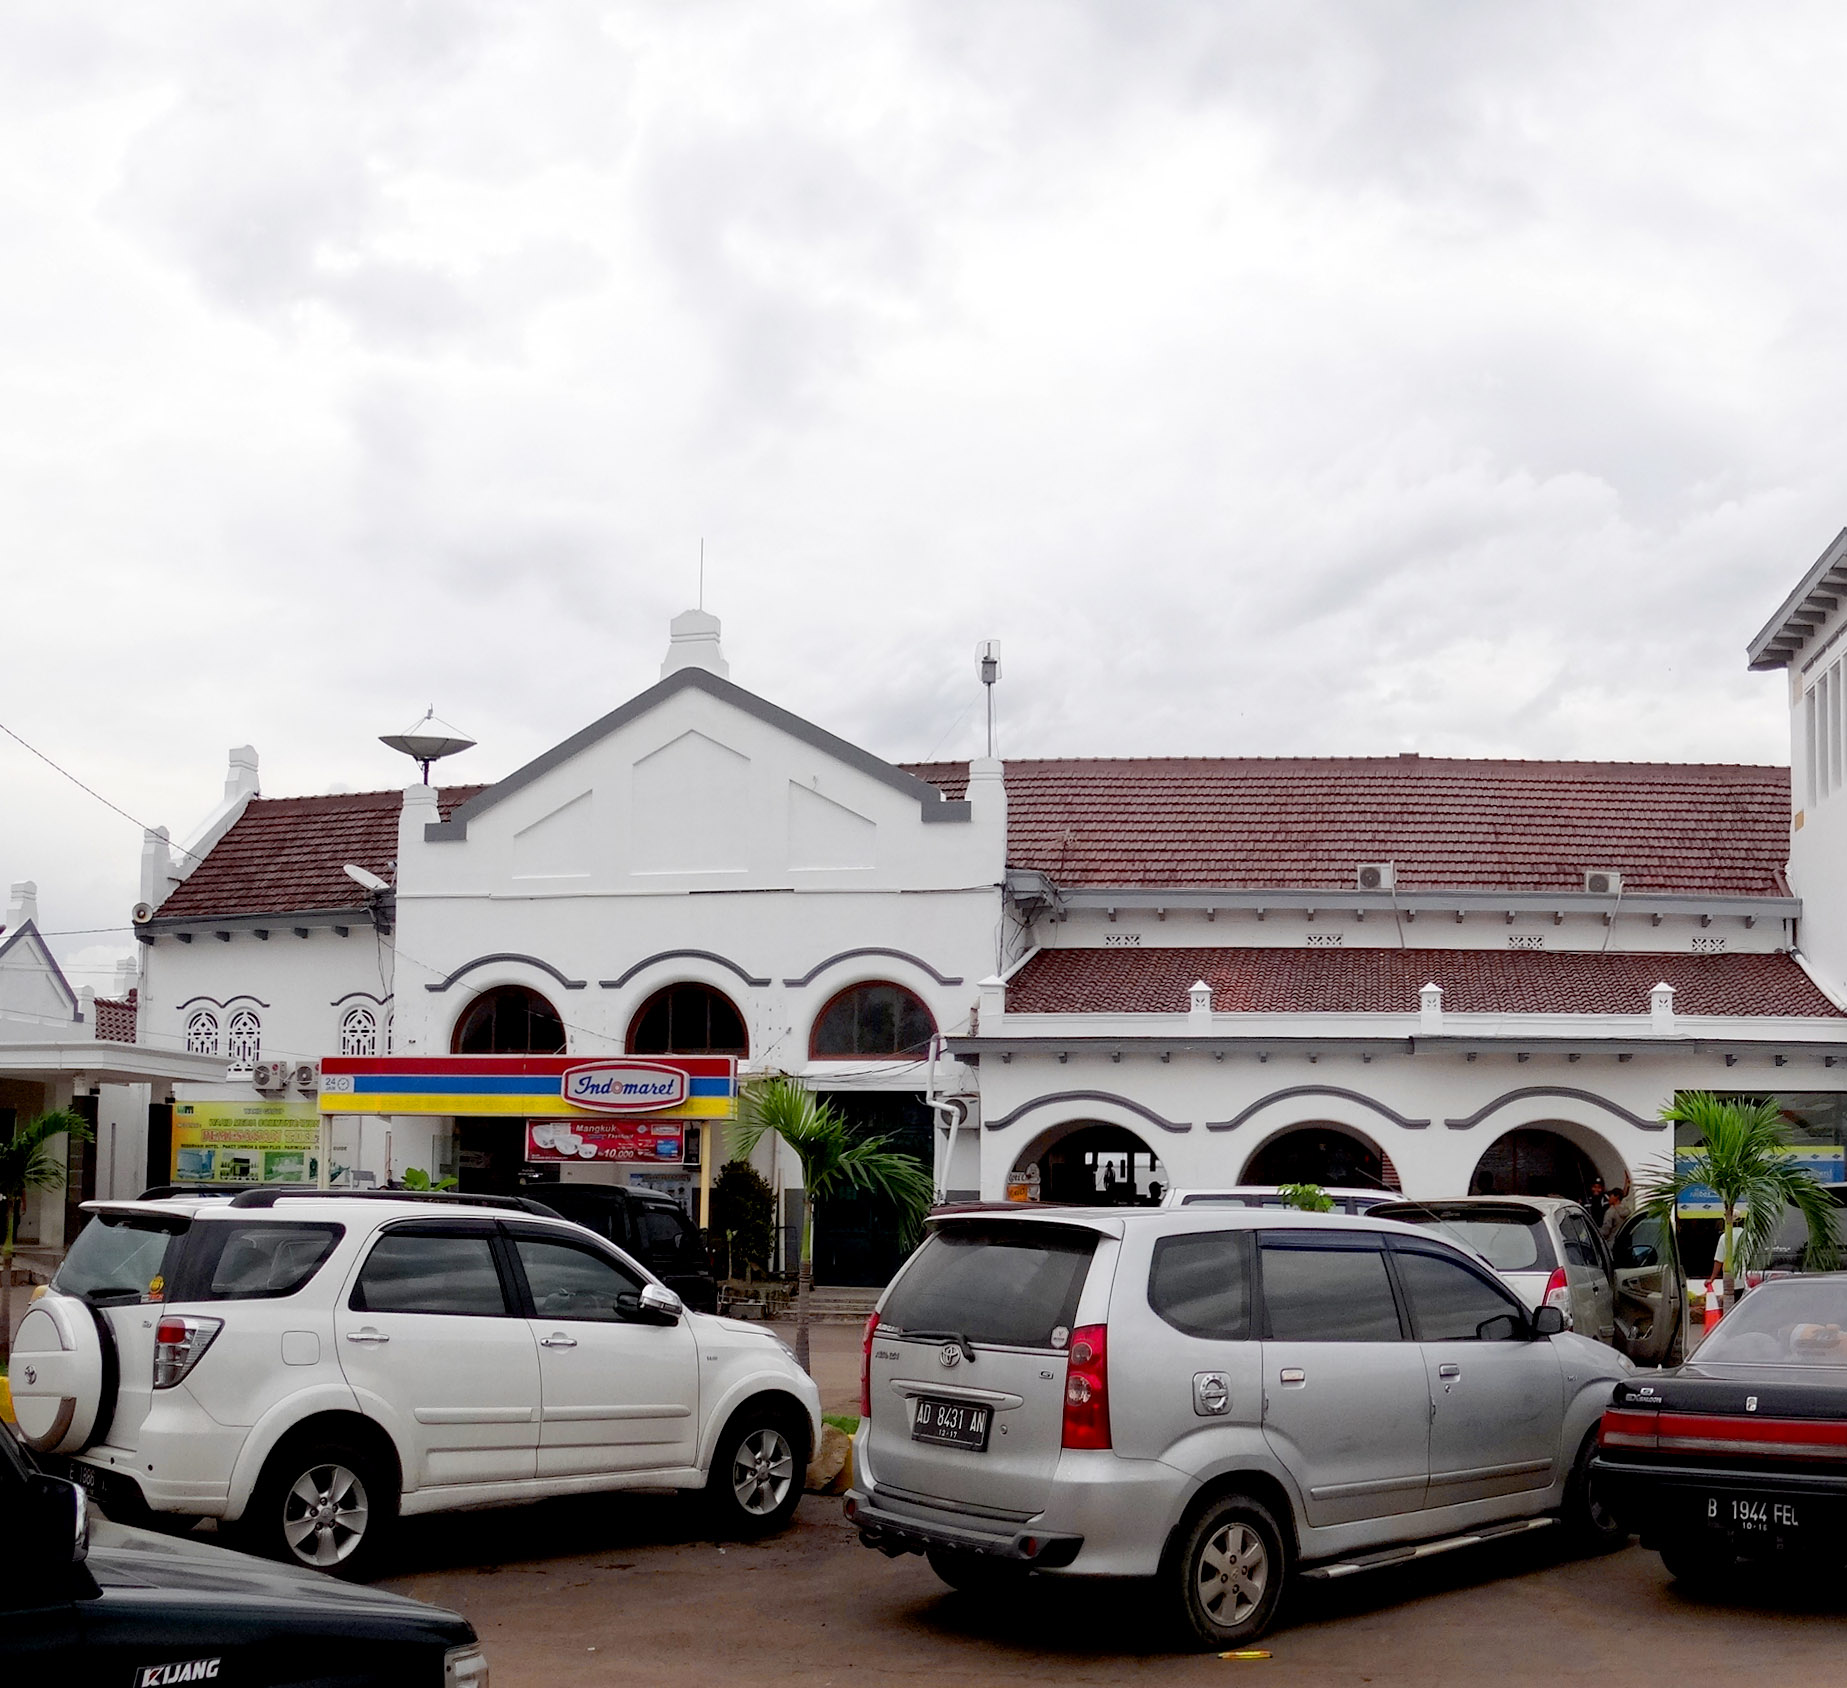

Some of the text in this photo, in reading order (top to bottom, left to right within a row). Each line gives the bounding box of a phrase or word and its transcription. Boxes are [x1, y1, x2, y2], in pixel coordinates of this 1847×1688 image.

[325, 1078, 336, 1086] 24
[574, 1076, 674, 1095] Indomaret
[576, 1124, 617, 1134] Mangkuk
[916, 1403, 985, 1433] AD 8431 AN
[1708, 1498, 1717, 1517] B
[1732, 1500, 1767, 1522] 1944
[141, 1659, 221, 1687] KIJANG
